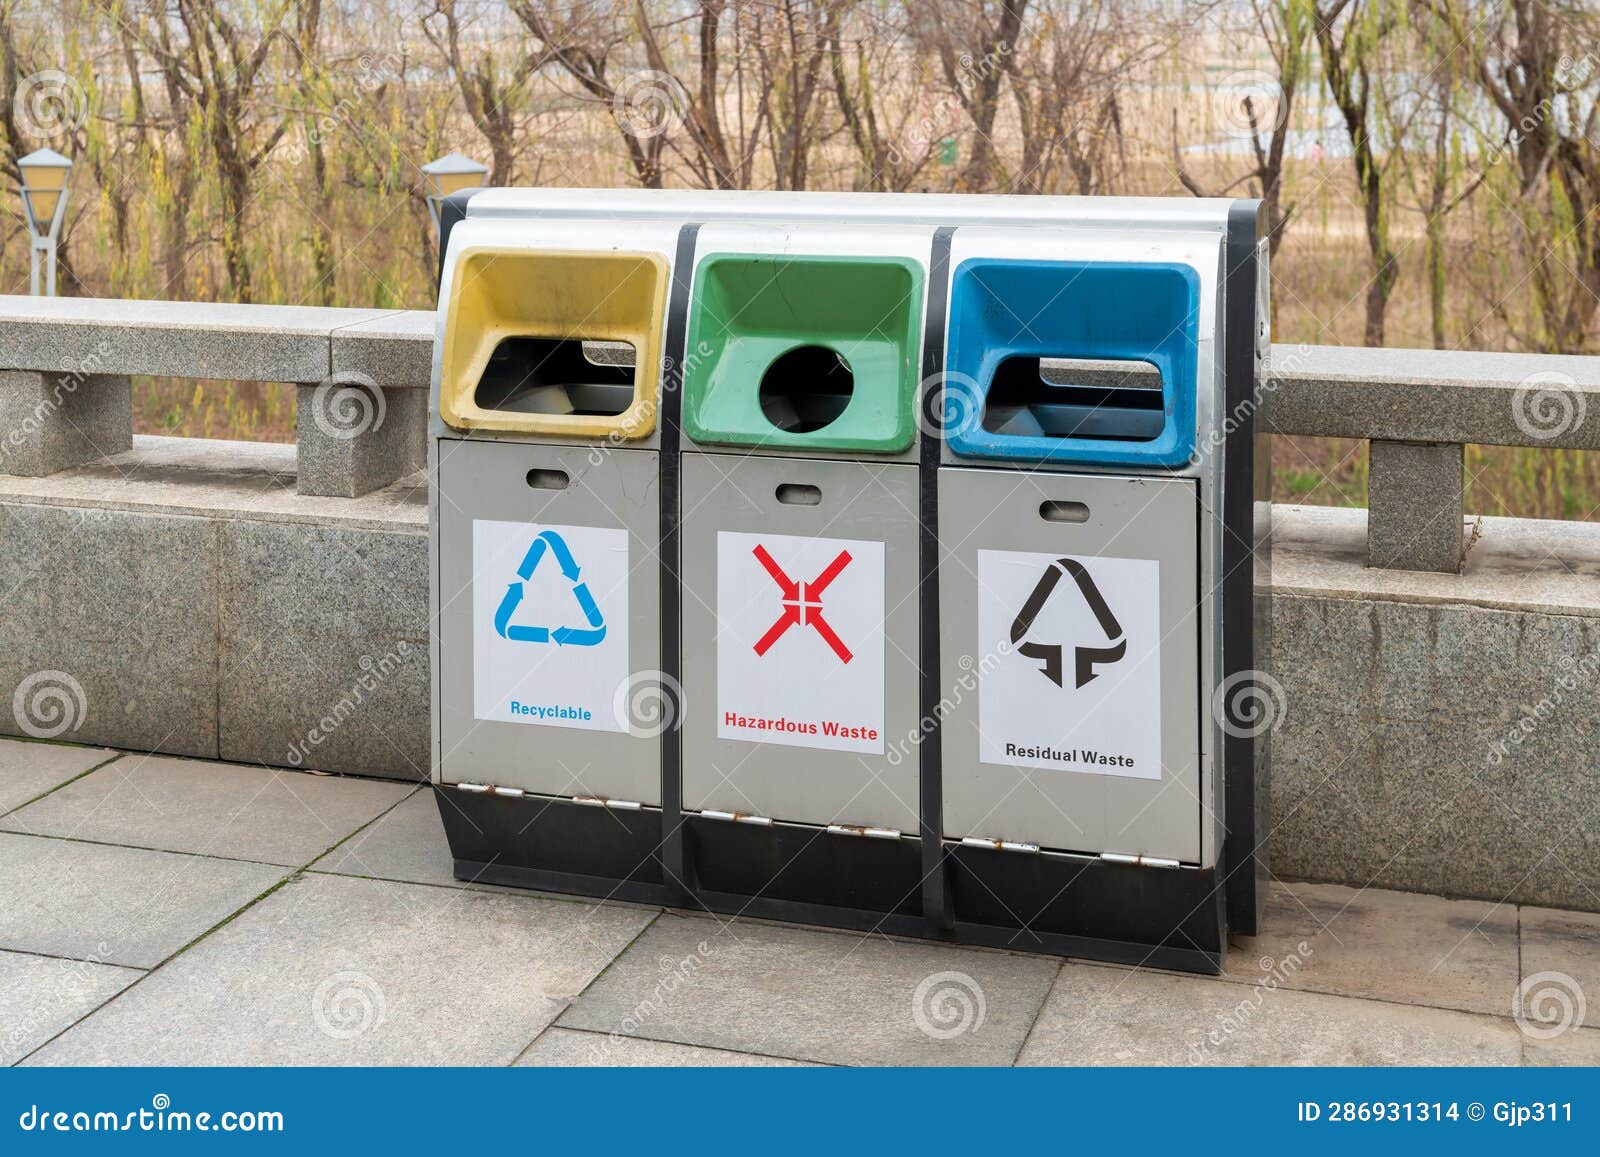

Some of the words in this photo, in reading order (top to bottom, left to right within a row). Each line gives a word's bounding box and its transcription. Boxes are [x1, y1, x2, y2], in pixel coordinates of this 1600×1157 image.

[510, 700, 592, 721] Recyclable
[725, 712, 817, 735] Hazardous
[821, 721, 878, 740] Waste
[1006, 743, 1077, 762] Residual
[1081, 750, 1135, 768] Waste
